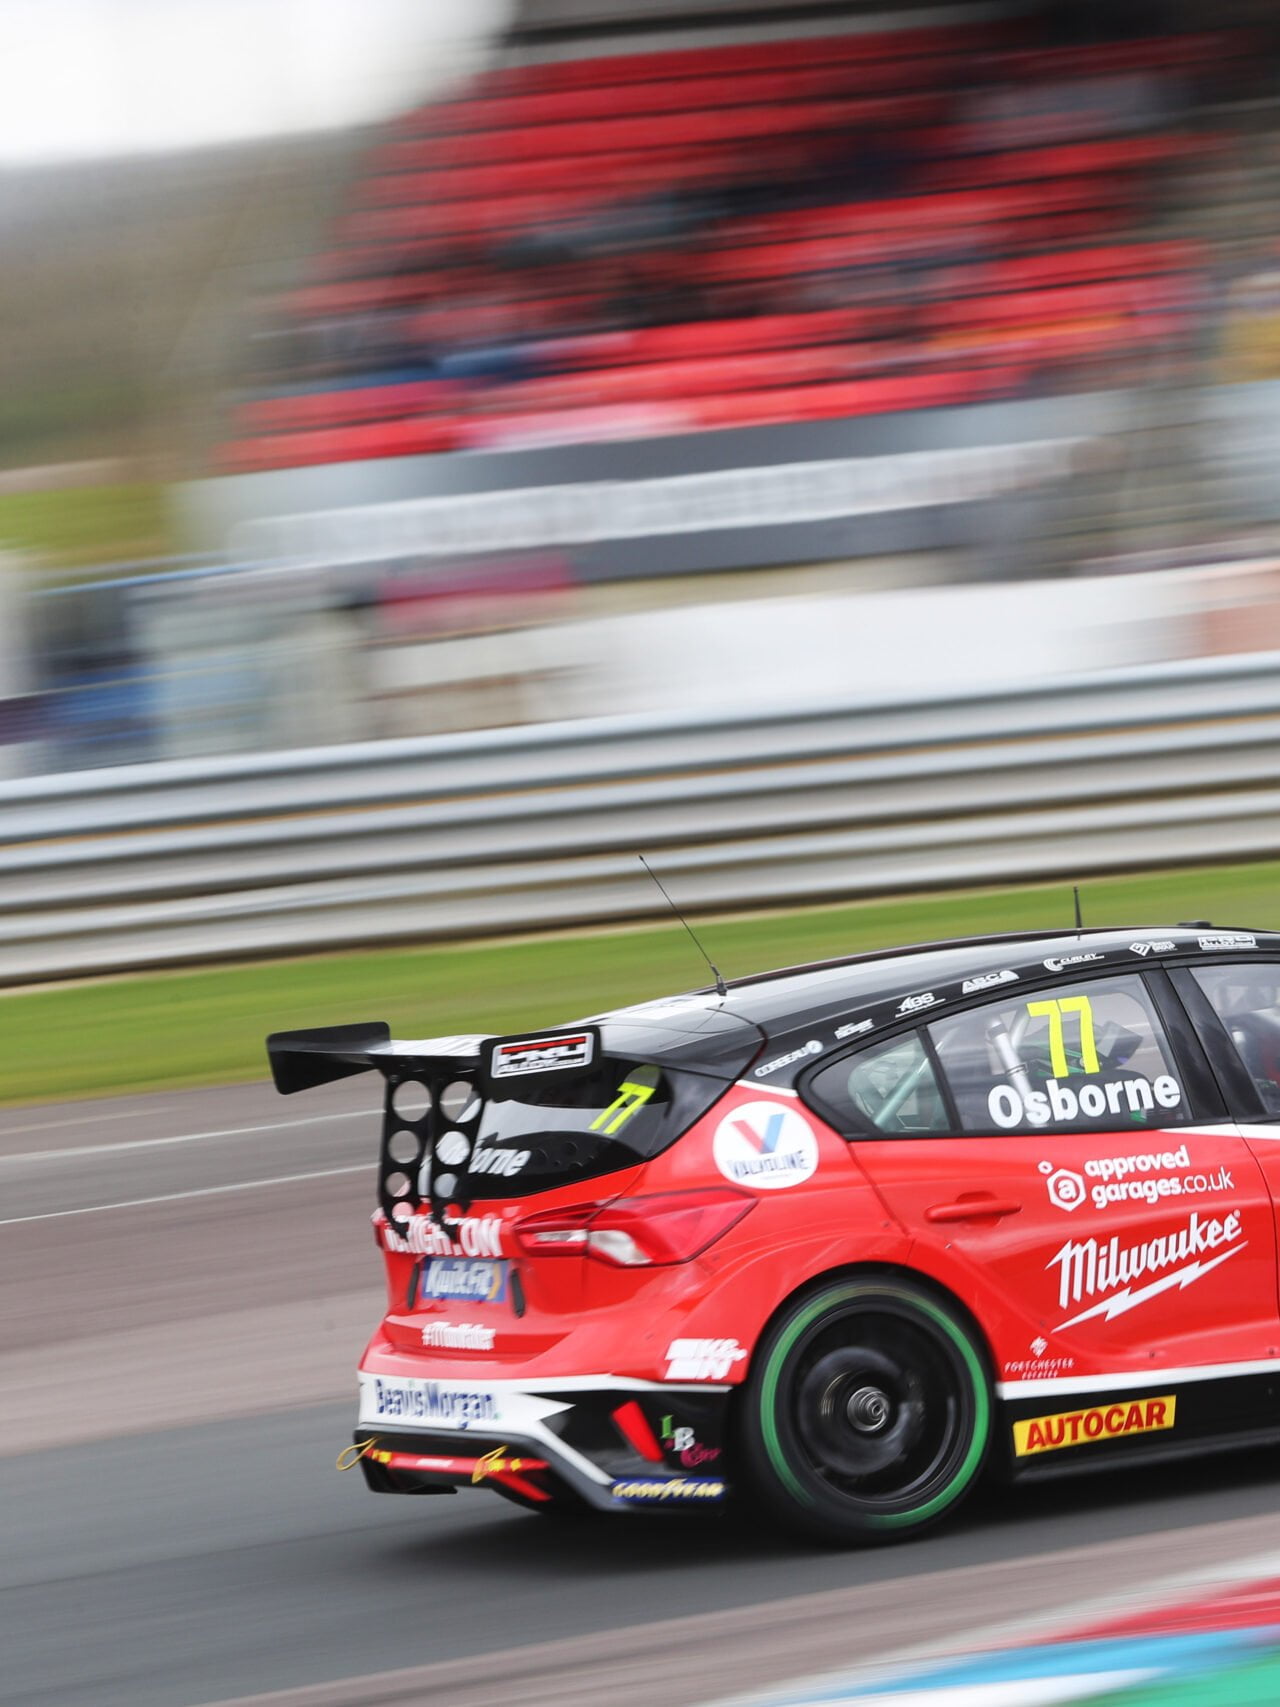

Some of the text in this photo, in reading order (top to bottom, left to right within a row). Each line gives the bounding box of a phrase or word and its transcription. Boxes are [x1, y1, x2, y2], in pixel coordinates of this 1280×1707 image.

[1027, 996, 1100, 1078] 77
[588, 1082, 656, 1134] 77
[988, 1074, 1181, 1129] Osborne
[1084, 1144, 1190, 1181] approved
[1091, 1166, 1235, 1209] garages.co.uk
[1044, 1211, 1242, 1309] Milwaukee
[1025, 1399, 1167, 1451] AUTOCAR
